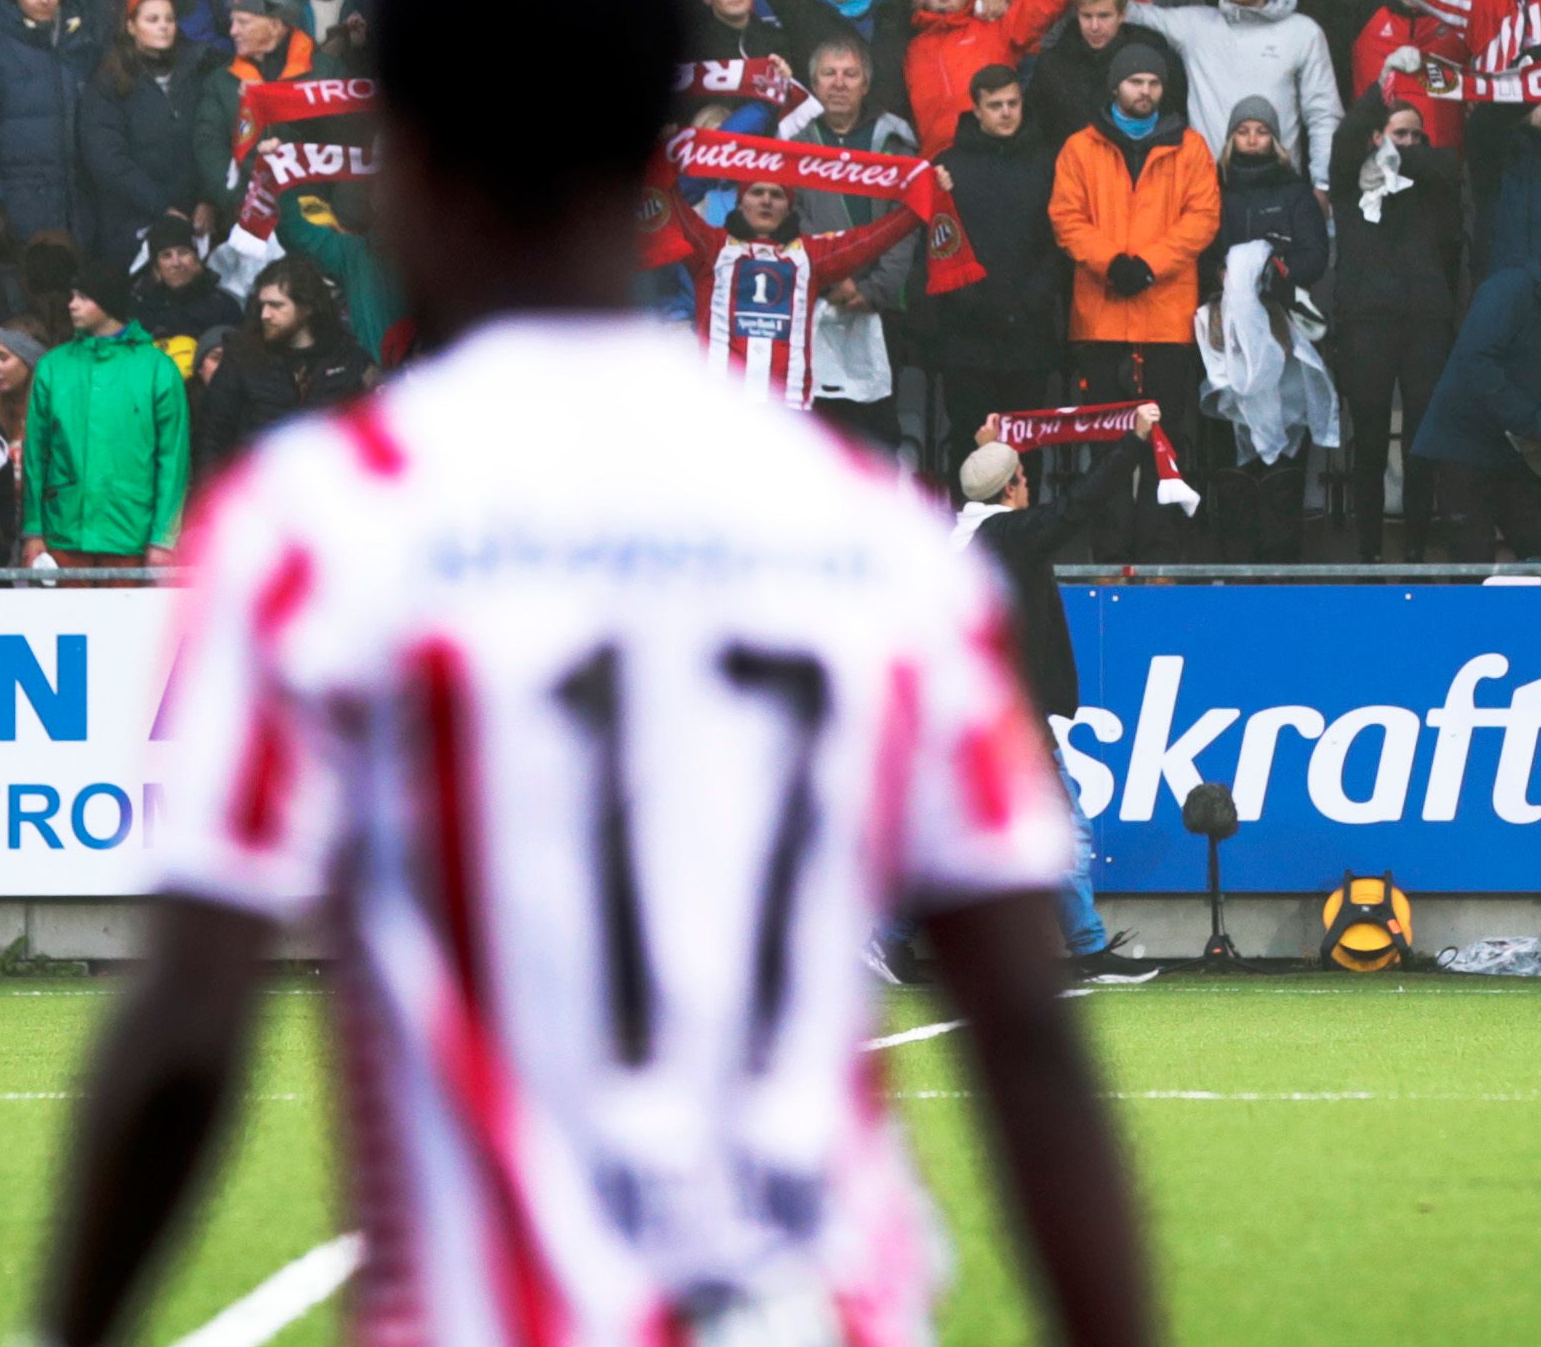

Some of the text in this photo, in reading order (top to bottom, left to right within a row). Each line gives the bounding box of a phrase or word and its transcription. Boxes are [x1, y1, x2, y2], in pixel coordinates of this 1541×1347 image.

[293, 78, 374, 105] TRO
[666, 127, 931, 190] Gutan våres!
[752, 272, 769, 304] 1
[552, 640, 834, 1072] 17
